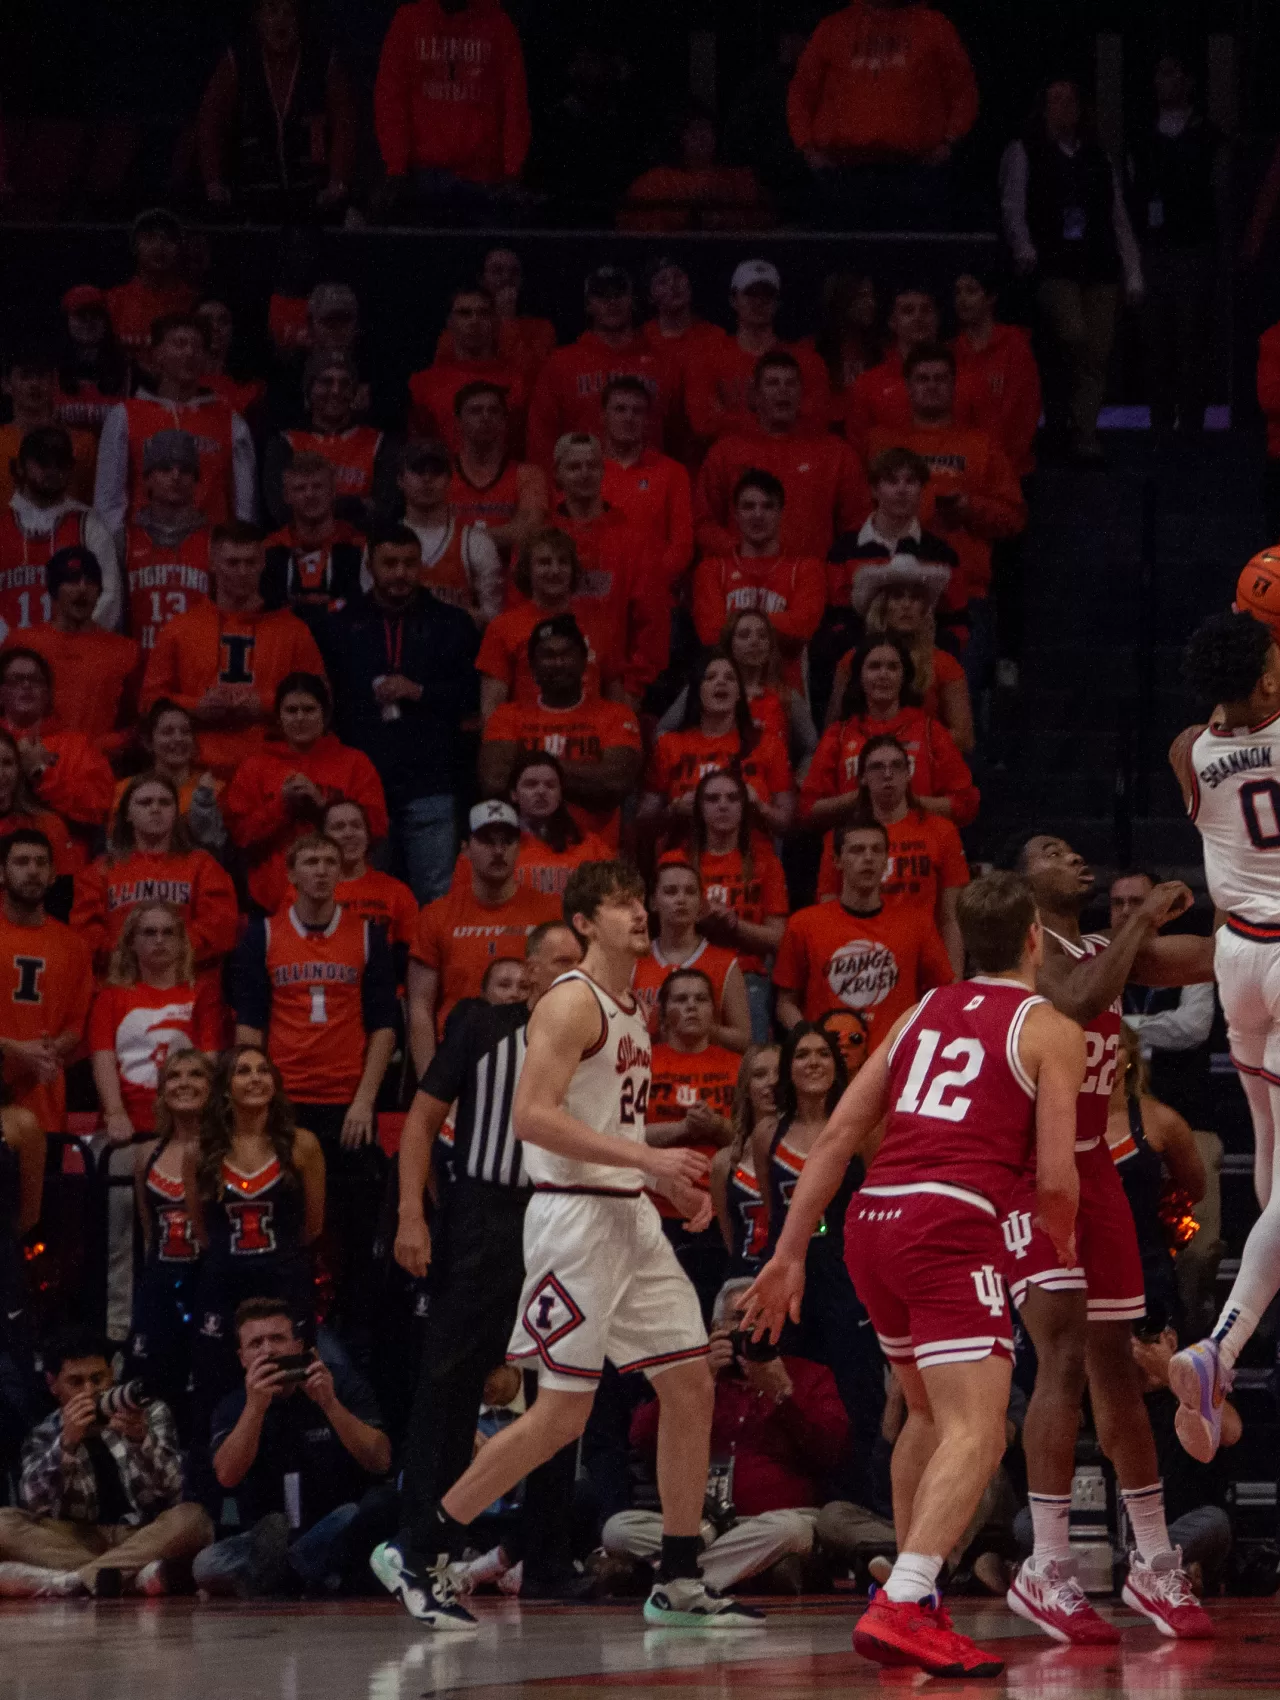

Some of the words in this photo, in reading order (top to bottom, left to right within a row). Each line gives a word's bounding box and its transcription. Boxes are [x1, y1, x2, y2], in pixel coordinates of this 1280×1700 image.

[219, 633, 255, 685] I
[1200, 746, 1273, 790] SHANNON
[14, 957, 45, 1003] I
[894, 1028, 986, 1123] 12
[1080, 1030, 1121, 1096] 22
[619, 1077, 649, 1124] 24
[536, 1295, 556, 1329] I
